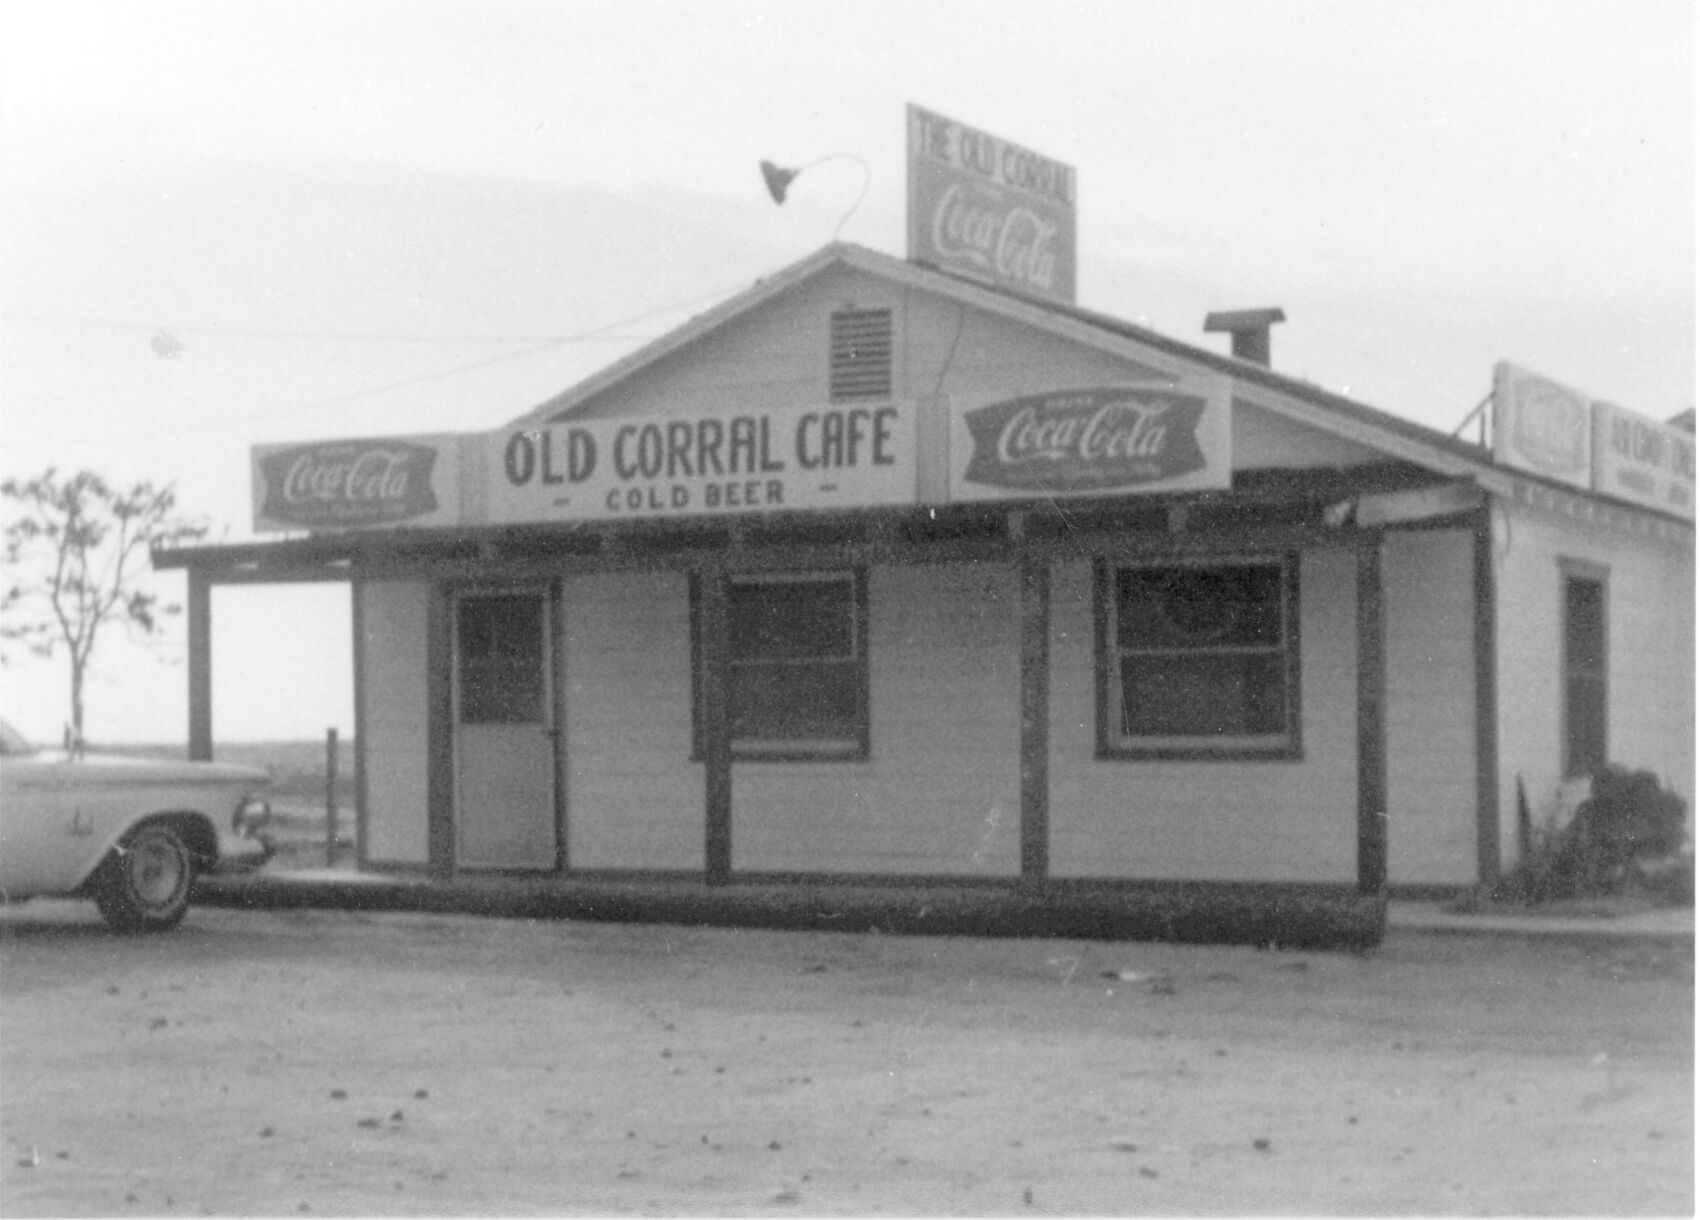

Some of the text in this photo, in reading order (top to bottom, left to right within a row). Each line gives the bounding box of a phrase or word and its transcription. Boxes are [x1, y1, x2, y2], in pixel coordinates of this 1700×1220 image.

[959, 125, 996, 176] OLD
[1002, 143, 1073, 207] CORRAL
[504, 406, 899, 487] OLD CORRAL CAFE
[998, 400, 1173, 463] Coca-Cola
[606, 478, 785, 511] COLD BEER
